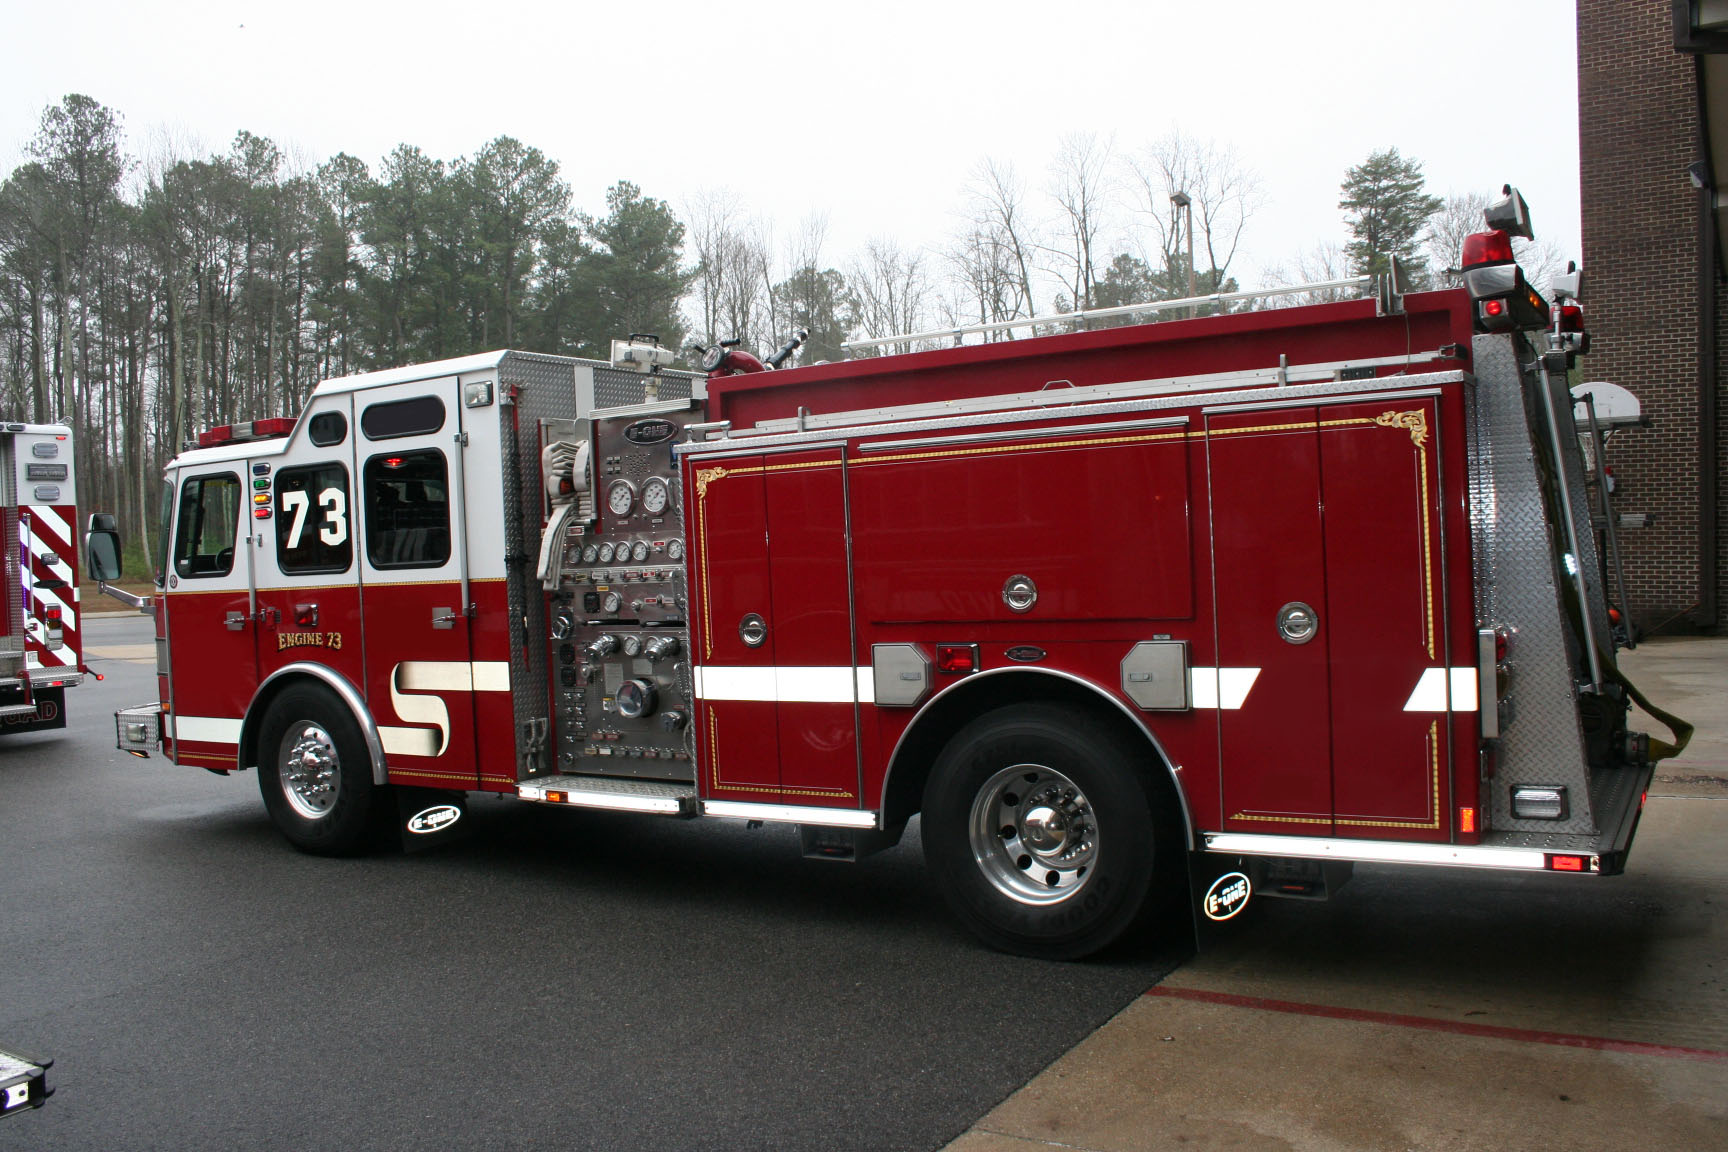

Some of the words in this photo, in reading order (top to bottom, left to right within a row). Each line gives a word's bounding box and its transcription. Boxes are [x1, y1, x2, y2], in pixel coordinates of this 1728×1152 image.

[282, 487, 347, 549] 73
[277, 632, 324, 650] ENGINE
[326, 632, 342, 650] 73
[1209, 879, 1246, 914] E-ONE
